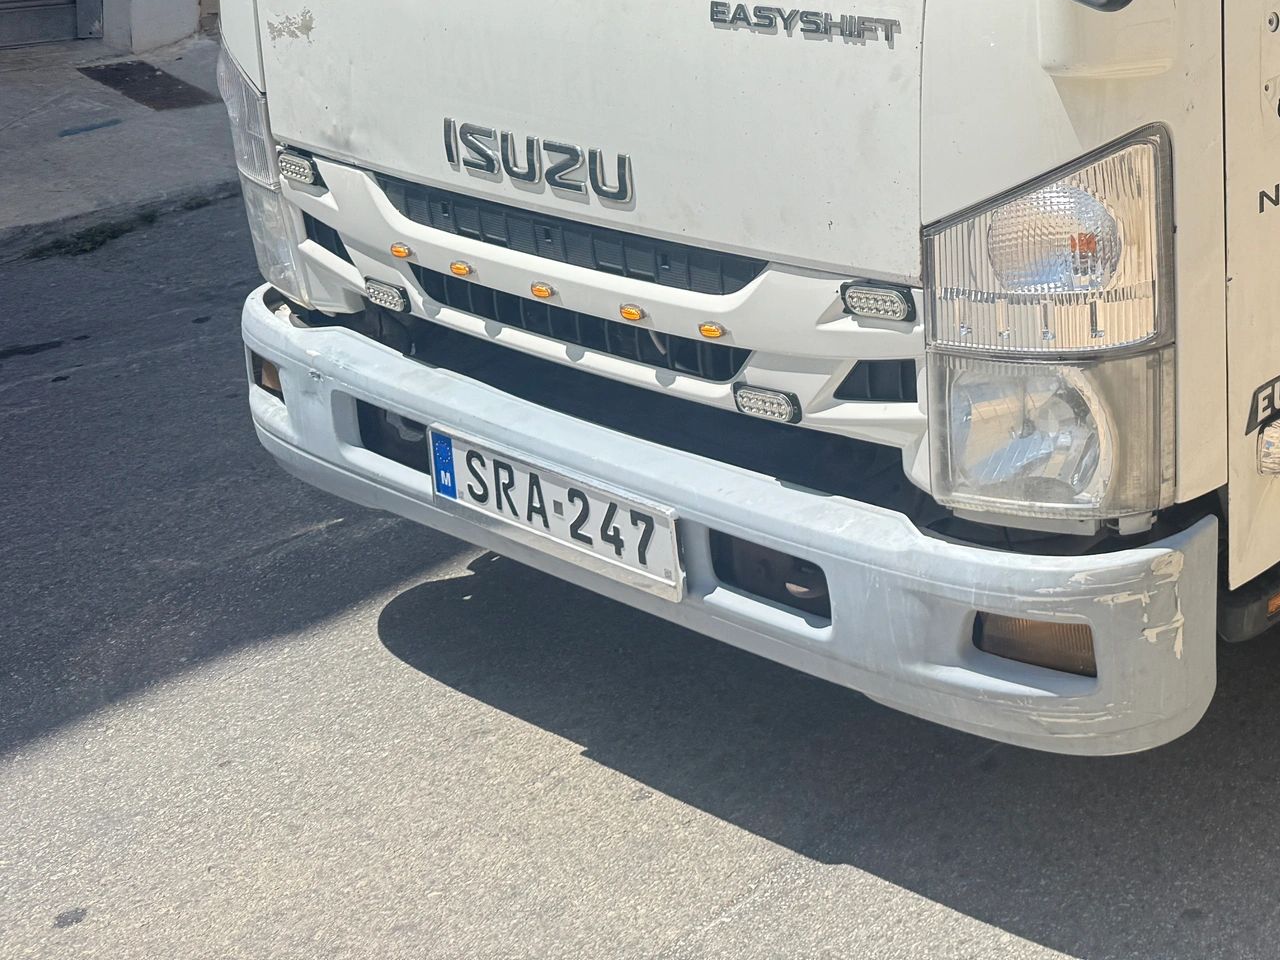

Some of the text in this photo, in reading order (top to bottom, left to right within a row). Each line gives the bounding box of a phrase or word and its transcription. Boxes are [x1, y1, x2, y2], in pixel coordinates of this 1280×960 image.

[709, 0, 901, 48] EASYSHIFT
[443, 117, 635, 206] ISUZU
[440, 470, 452, 488] M
